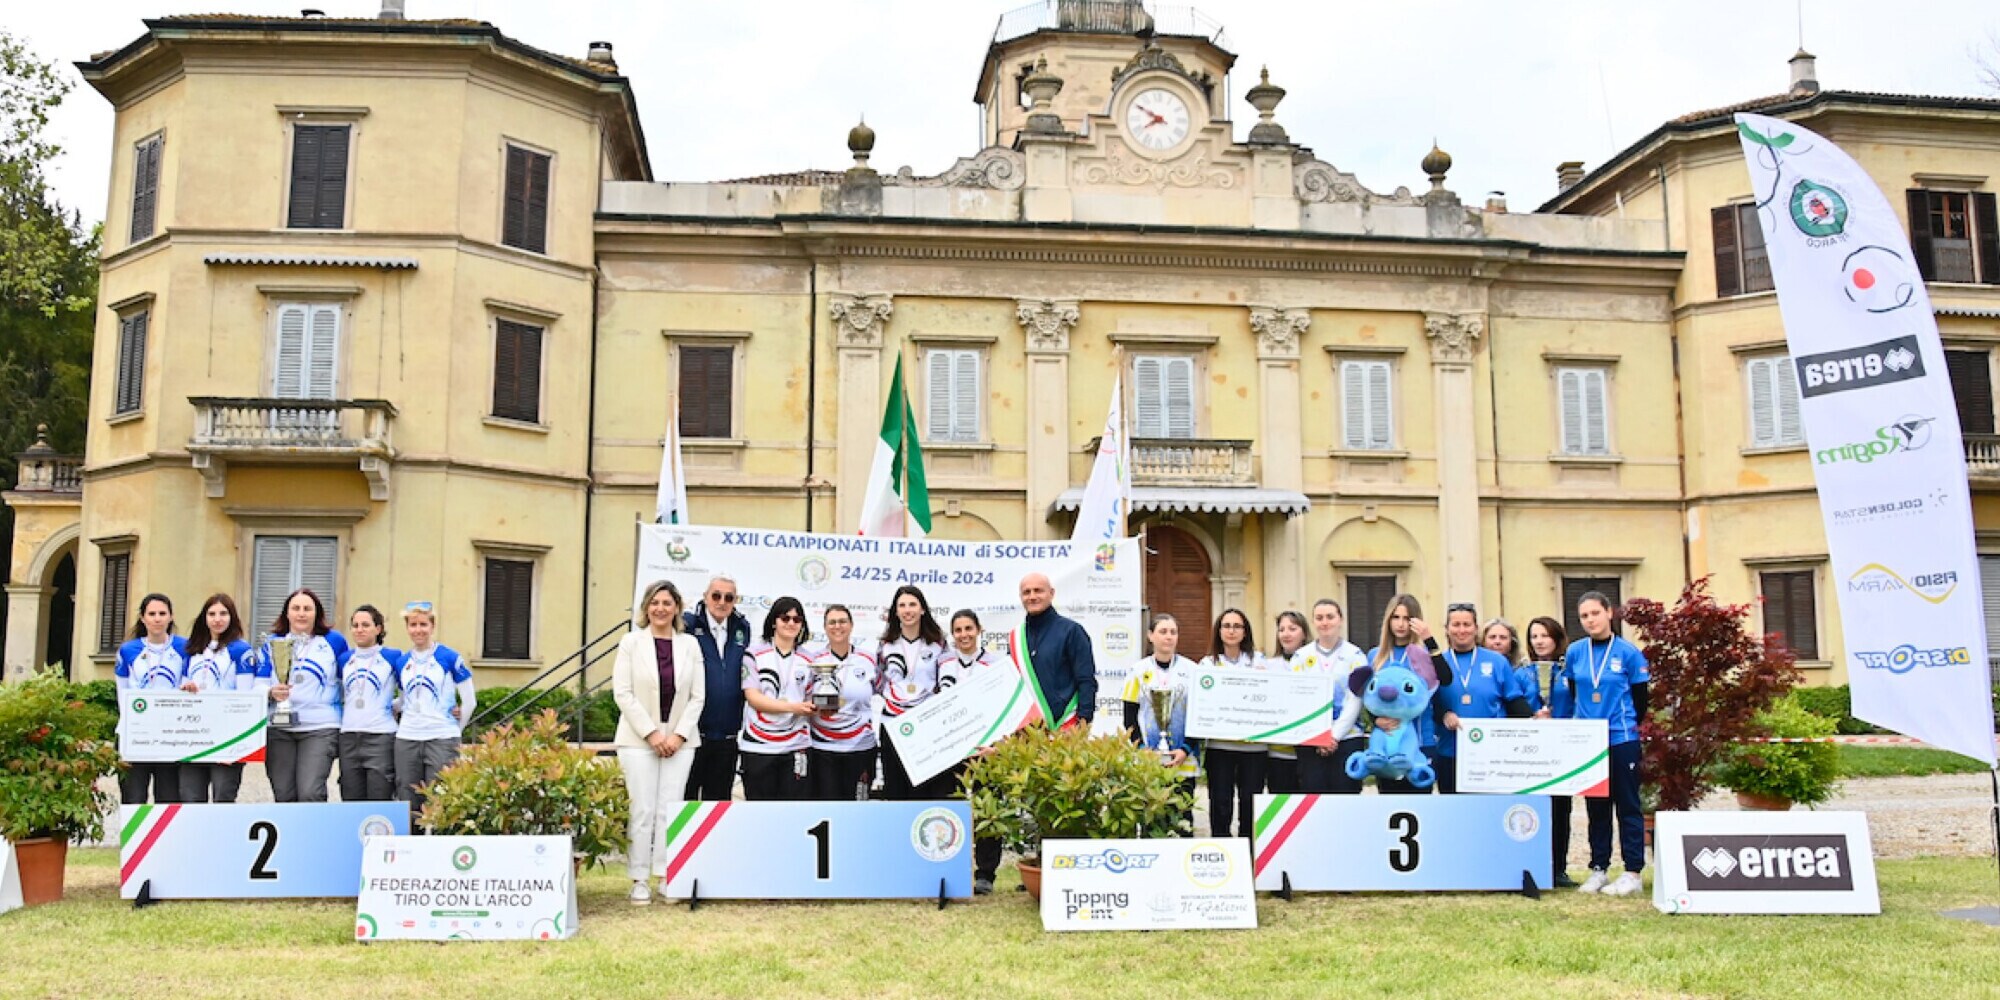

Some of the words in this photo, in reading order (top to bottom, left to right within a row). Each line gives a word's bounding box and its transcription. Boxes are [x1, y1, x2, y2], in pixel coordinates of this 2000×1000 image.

[722, 530, 758, 547] XXII
[763, 533, 879, 554] CAMPIONATI
[889, 541, 965, 558] ITALIANI
[975, 545, 991, 559] di
[841, 565, 892, 582] 24/25
[896, 568, 948, 586] Aprile
[953, 571, 994, 585] 2024
[248, 821, 278, 879] 2
[806, 820, 830, 879] 1
[1389, 812, 1420, 872] 3
[1052, 848, 1160, 874] DiSPORT
[1191, 852, 1225, 863] RIGI
[1738, 846, 1841, 878] errea
[370, 878, 480, 891] FEDERAZIONE
[484, 878, 554, 891] ITALIANA
[394, 893, 430, 907] TIRO
[435, 893, 470, 907] CON
[475, 893, 532, 907] L'ARCO
[1062, 888, 1129, 908] Tipping
